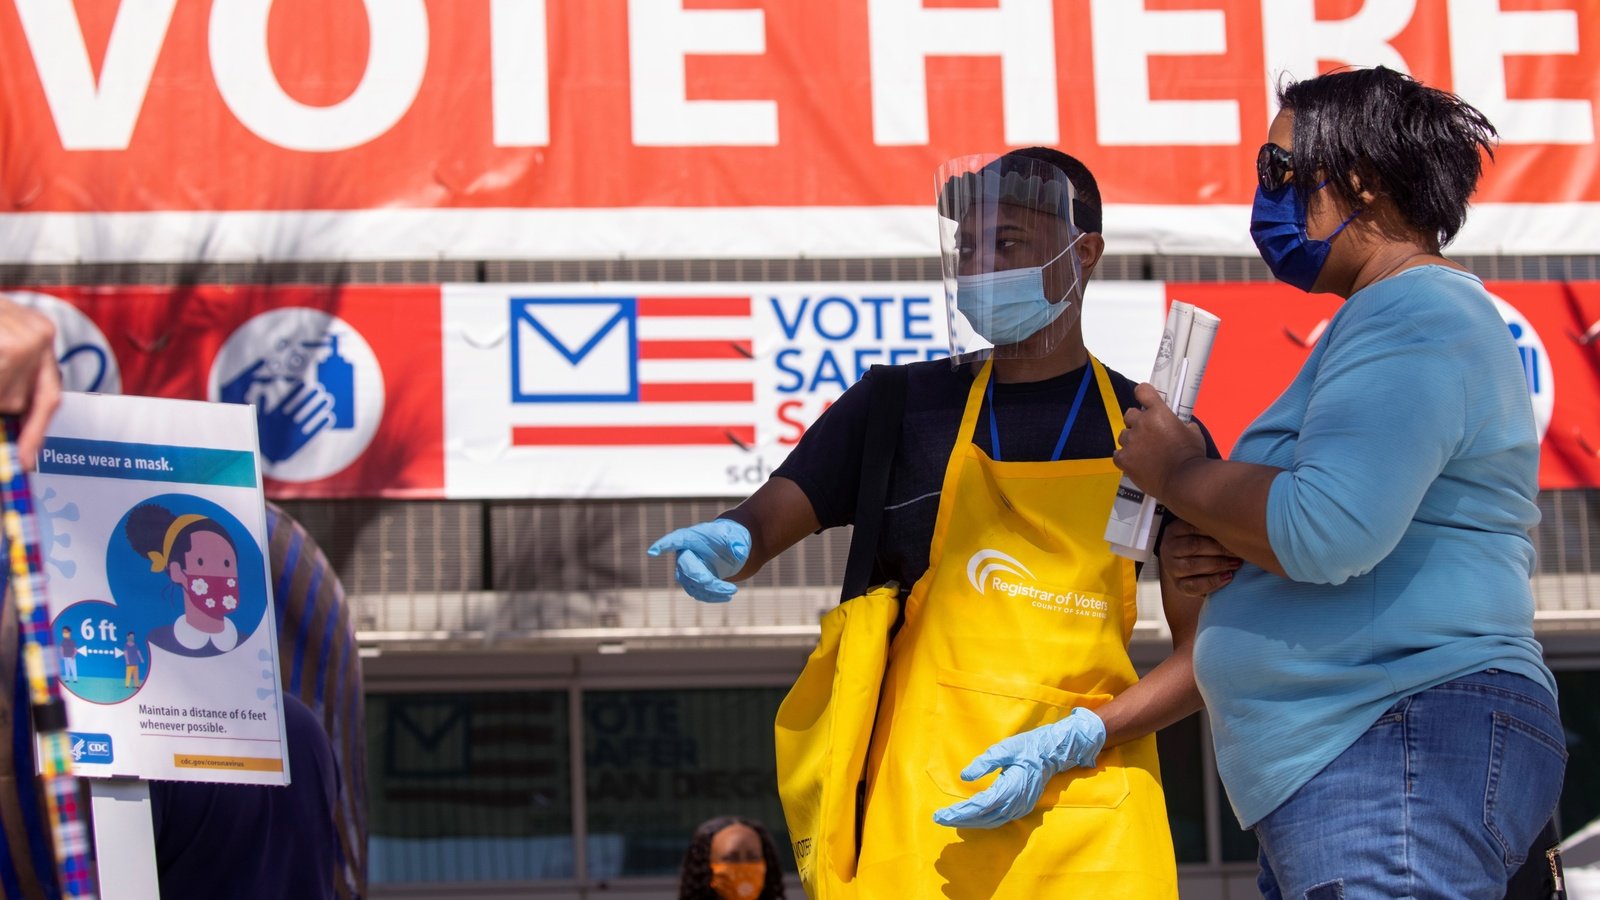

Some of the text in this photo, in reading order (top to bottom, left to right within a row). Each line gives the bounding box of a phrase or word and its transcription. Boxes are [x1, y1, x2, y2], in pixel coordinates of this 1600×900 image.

[769, 296, 934, 341] VOTE
[774, 346, 966, 393] SAF
[43, 448, 174, 472] Please wear a mask.
[992, 577, 1108, 611] Registrar of Voters
[1031, 601, 1062, 613] COUNTY
[1075, 609, 1090, 617] SAN
[80, 617, 118, 642] 6 ft
[139, 704, 267, 721] Maintain a distance of 6 feet
[140, 719, 228, 734] whenever possible.
[88, 743, 109, 753] CDC
[180, 758, 245, 769] cdc.gov/coronavirus
